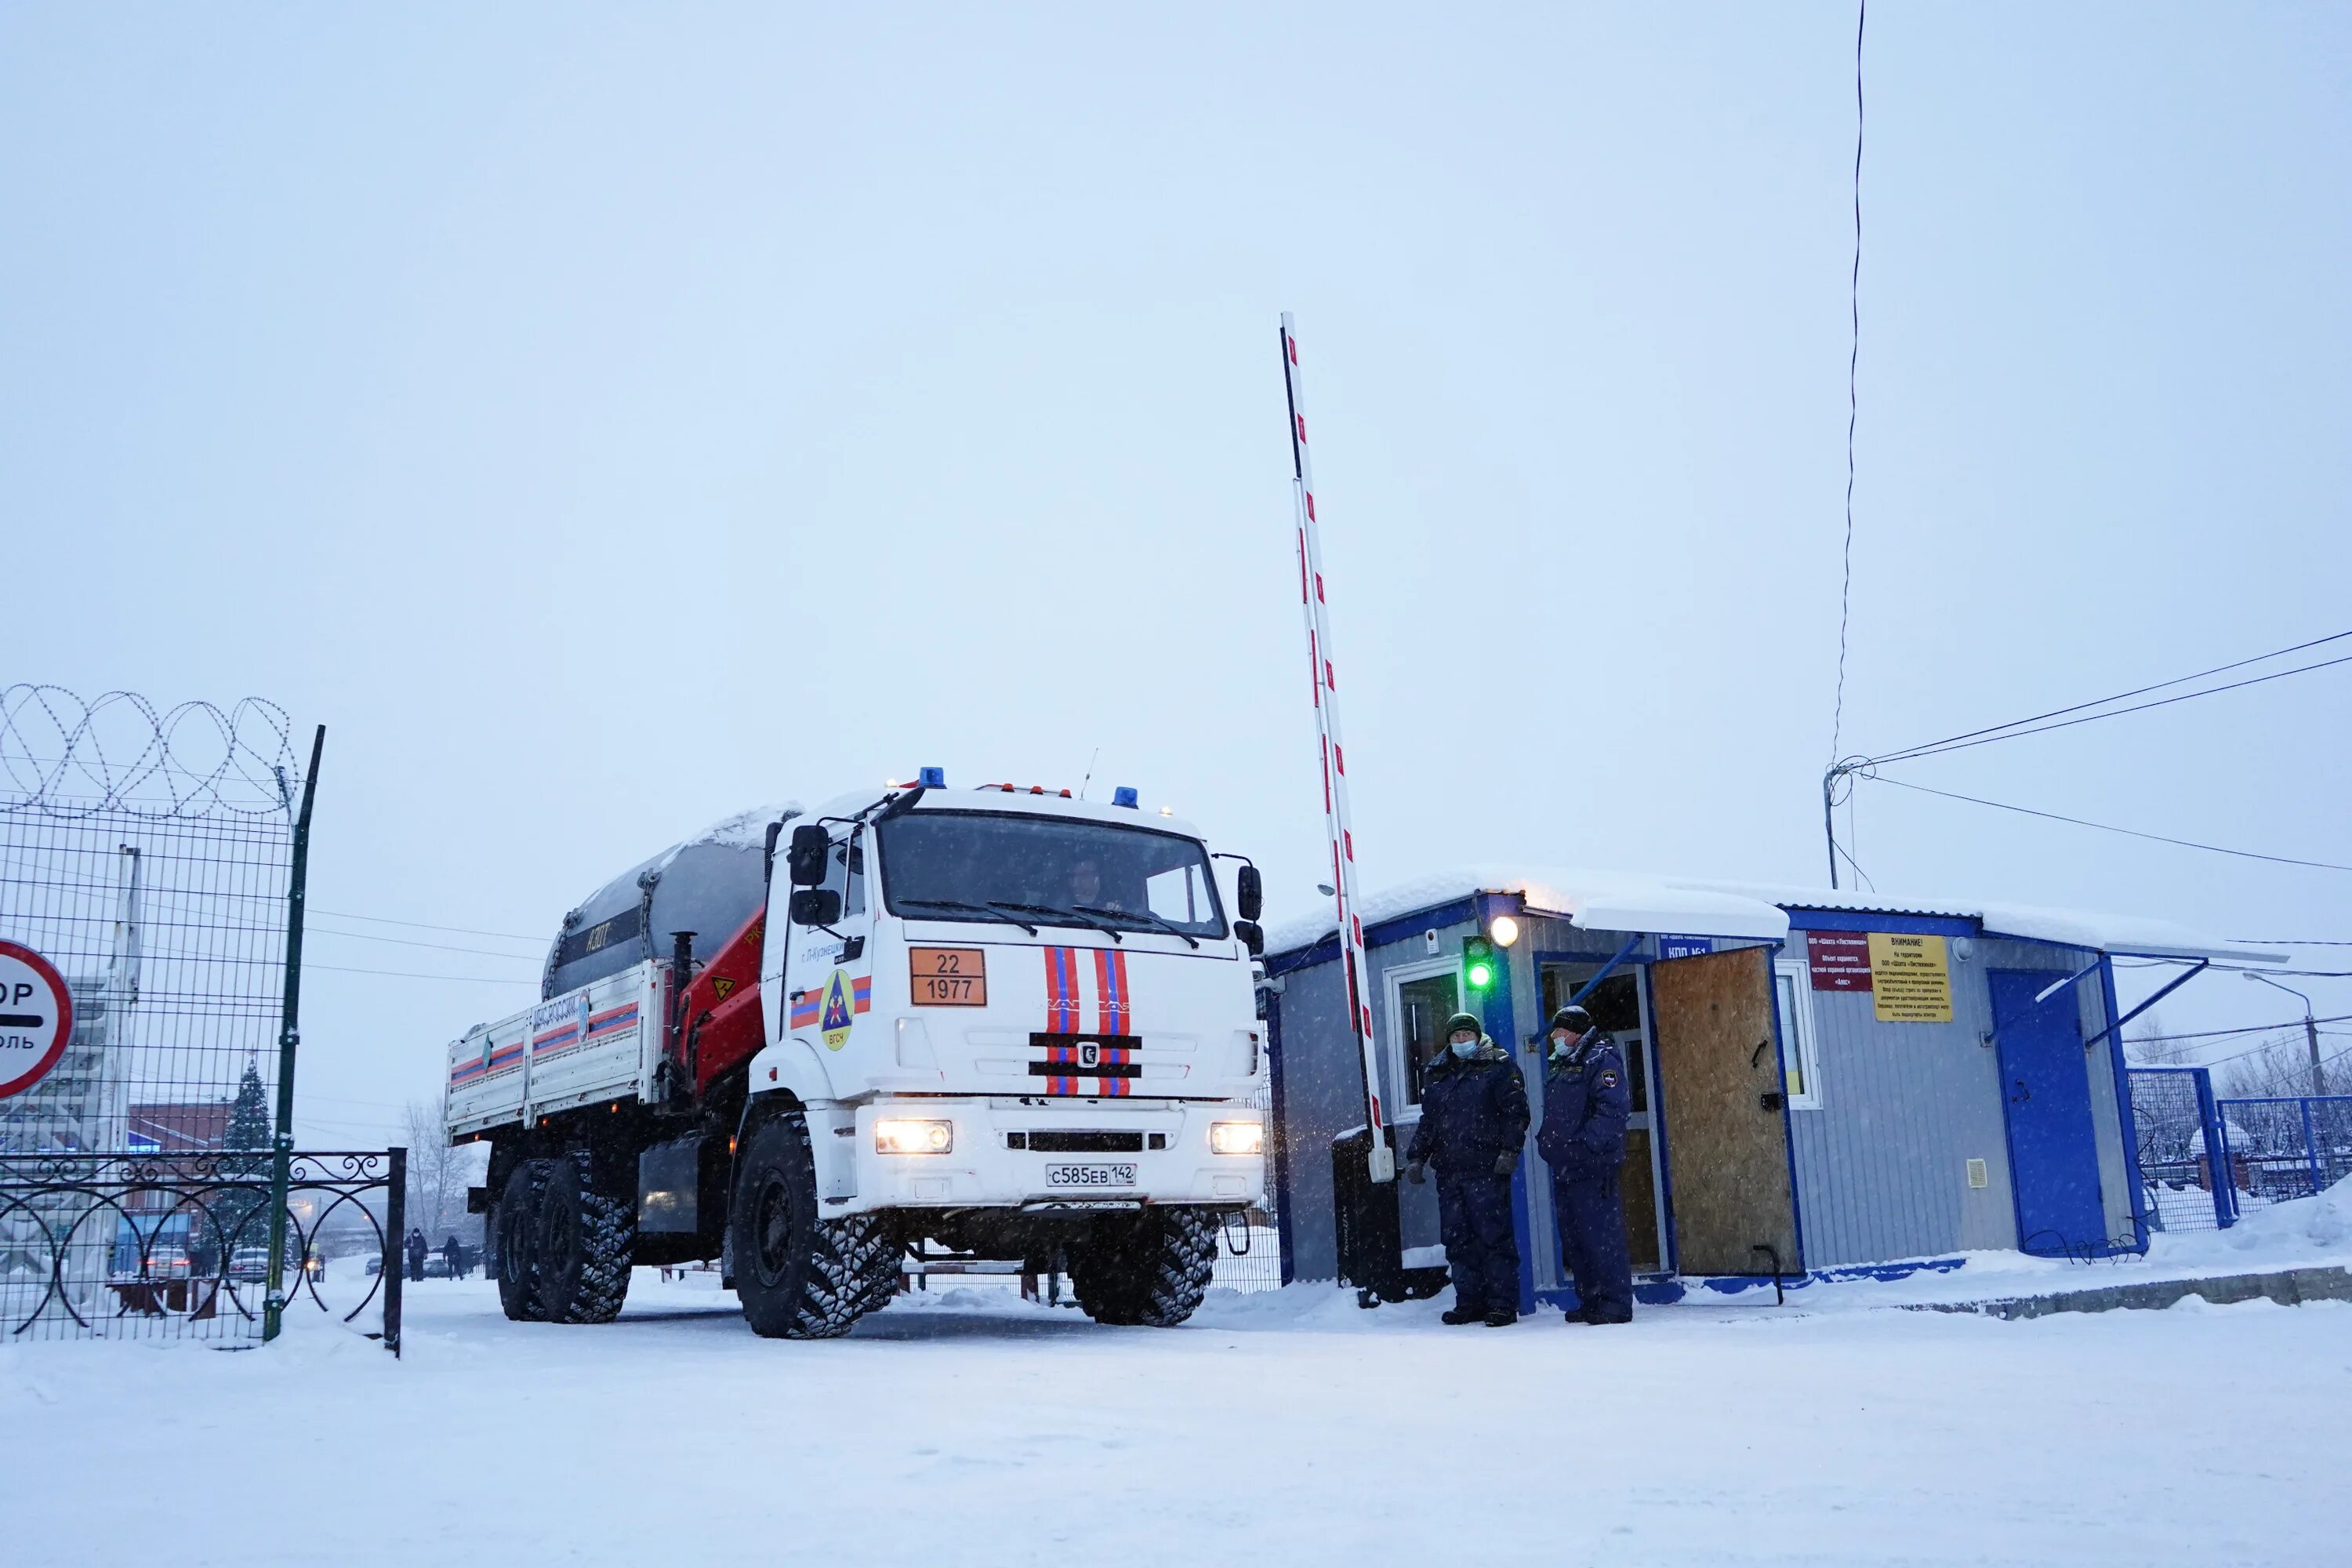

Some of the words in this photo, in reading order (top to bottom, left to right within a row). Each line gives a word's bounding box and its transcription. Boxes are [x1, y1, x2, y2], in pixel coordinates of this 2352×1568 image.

[586, 921, 611, 953] АЗОТ
[1891, 937, 1923, 947] ВНИМАНИЕ!
[1668, 947, 1687, 958] КПП
[936, 954, 960, 974] 22
[927, 978, 972, 999] 1977
[829, 1033, 844, 1044] ВГСЧ
[1051, 1167, 1108, 1184] С585ЕВ
[1111, 1166, 1132, 1178] 142
